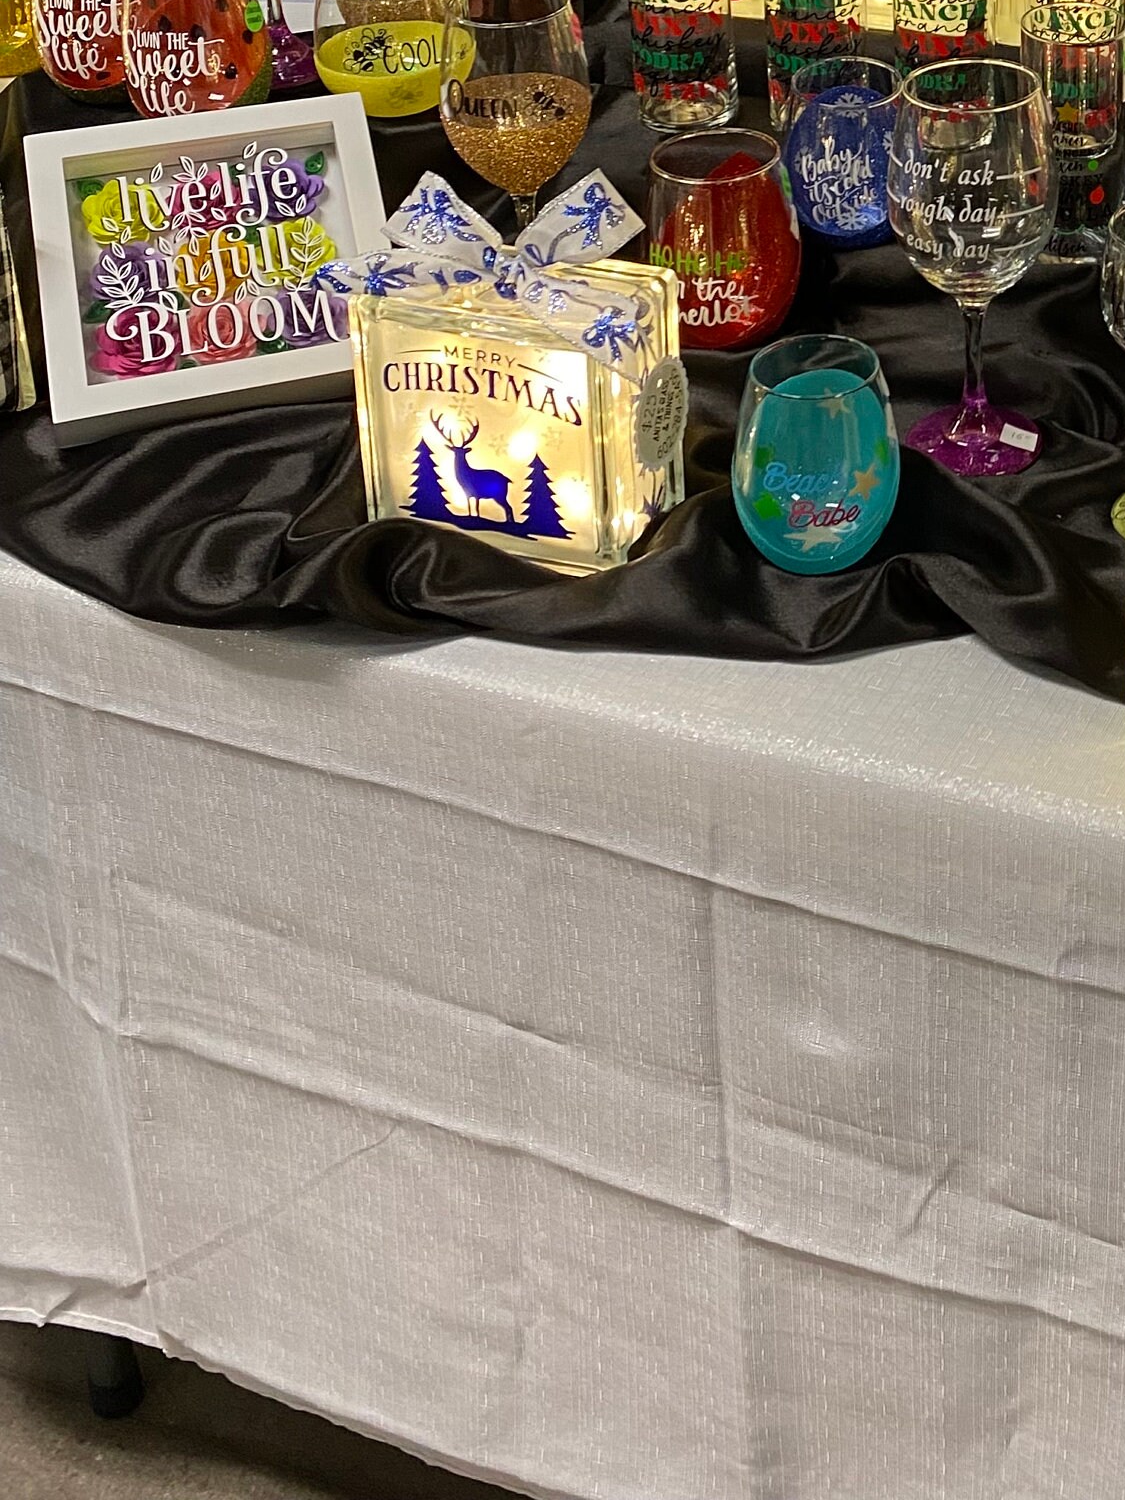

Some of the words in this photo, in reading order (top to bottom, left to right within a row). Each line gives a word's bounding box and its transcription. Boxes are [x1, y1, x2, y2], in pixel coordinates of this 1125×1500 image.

[51, 34, 108, 79] life
[165, 32, 190, 51] THE
[382, 34, 441, 75] COOL
[140, 77, 196, 117] life
[802, 135, 864, 183] Baby
[904, 149, 950, 183] don't
[957, 159, 995, 186] ask
[115, 174, 208, 233] live
[216, 147, 298, 226] life
[958, 194, 999, 230] day
[145, 247, 199, 293] in
[191, 223, 292, 306] full
[906, 233, 944, 262] easy
[952, 235, 991, 264] day
[105, 289, 351, 363] BLOOM
[444, 345, 517, 367] MERRY
[382, 361, 584, 427] CHRISTMAS
[788, 498, 861, 529] Babe
